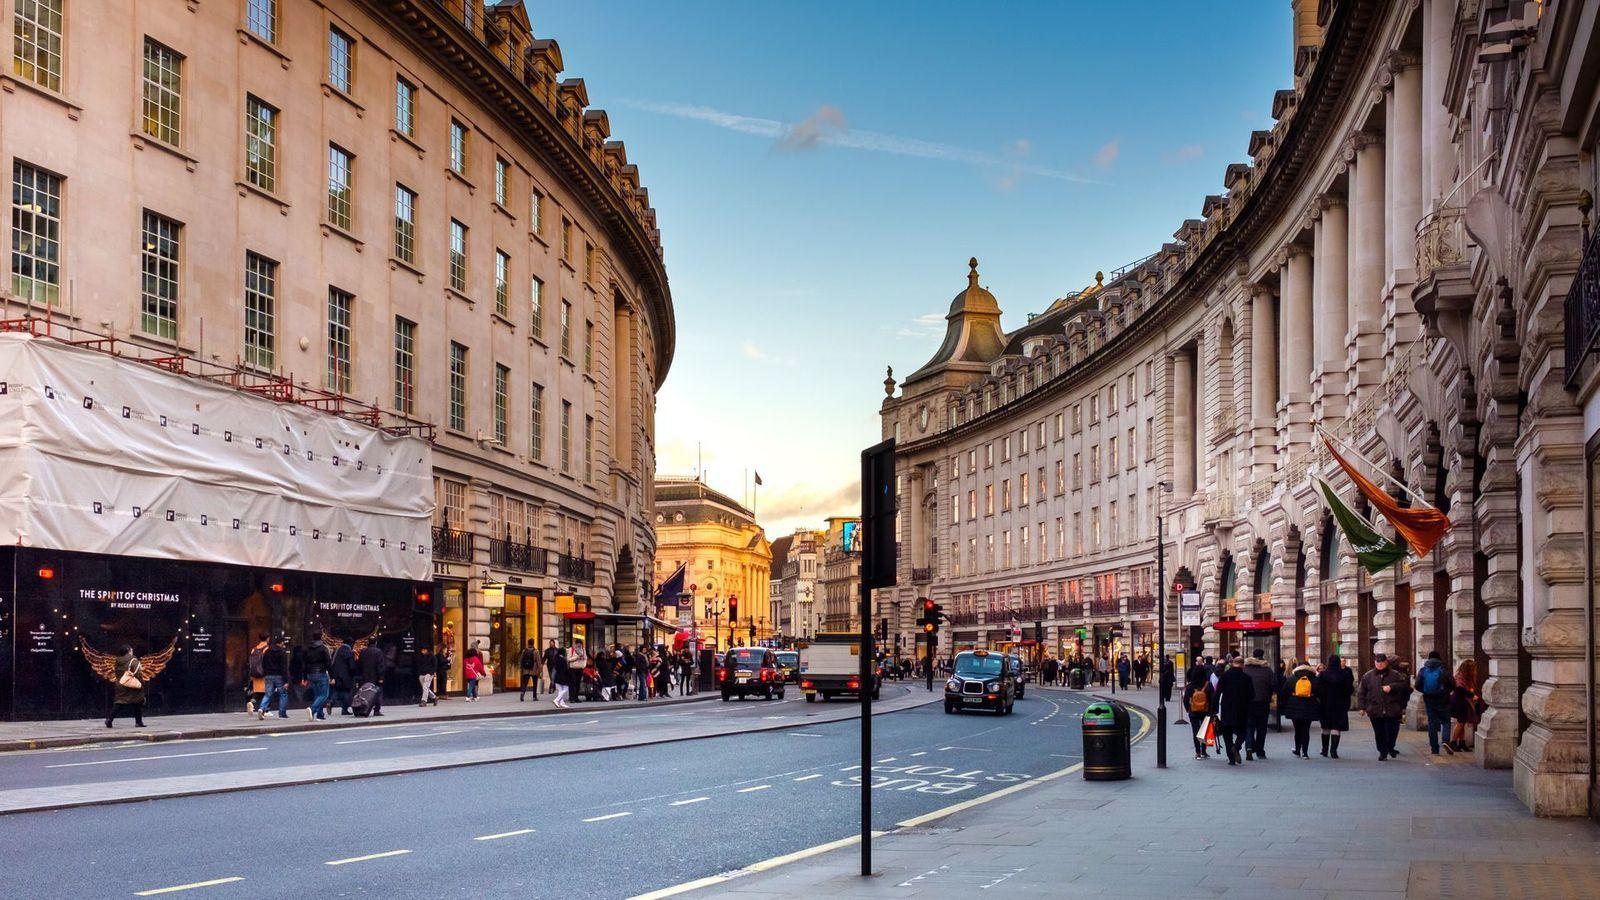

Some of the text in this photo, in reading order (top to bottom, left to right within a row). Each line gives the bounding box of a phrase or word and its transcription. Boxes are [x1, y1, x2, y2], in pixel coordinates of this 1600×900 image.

[80, 589, 95, 599] THE
[124, 592, 136, 600] OF
[136, 592, 180, 602] CHRISTMAS
[320, 602, 329, 610] THE
[840, 764, 1032, 782] STOP
[831, 775, 978, 795] BUS
